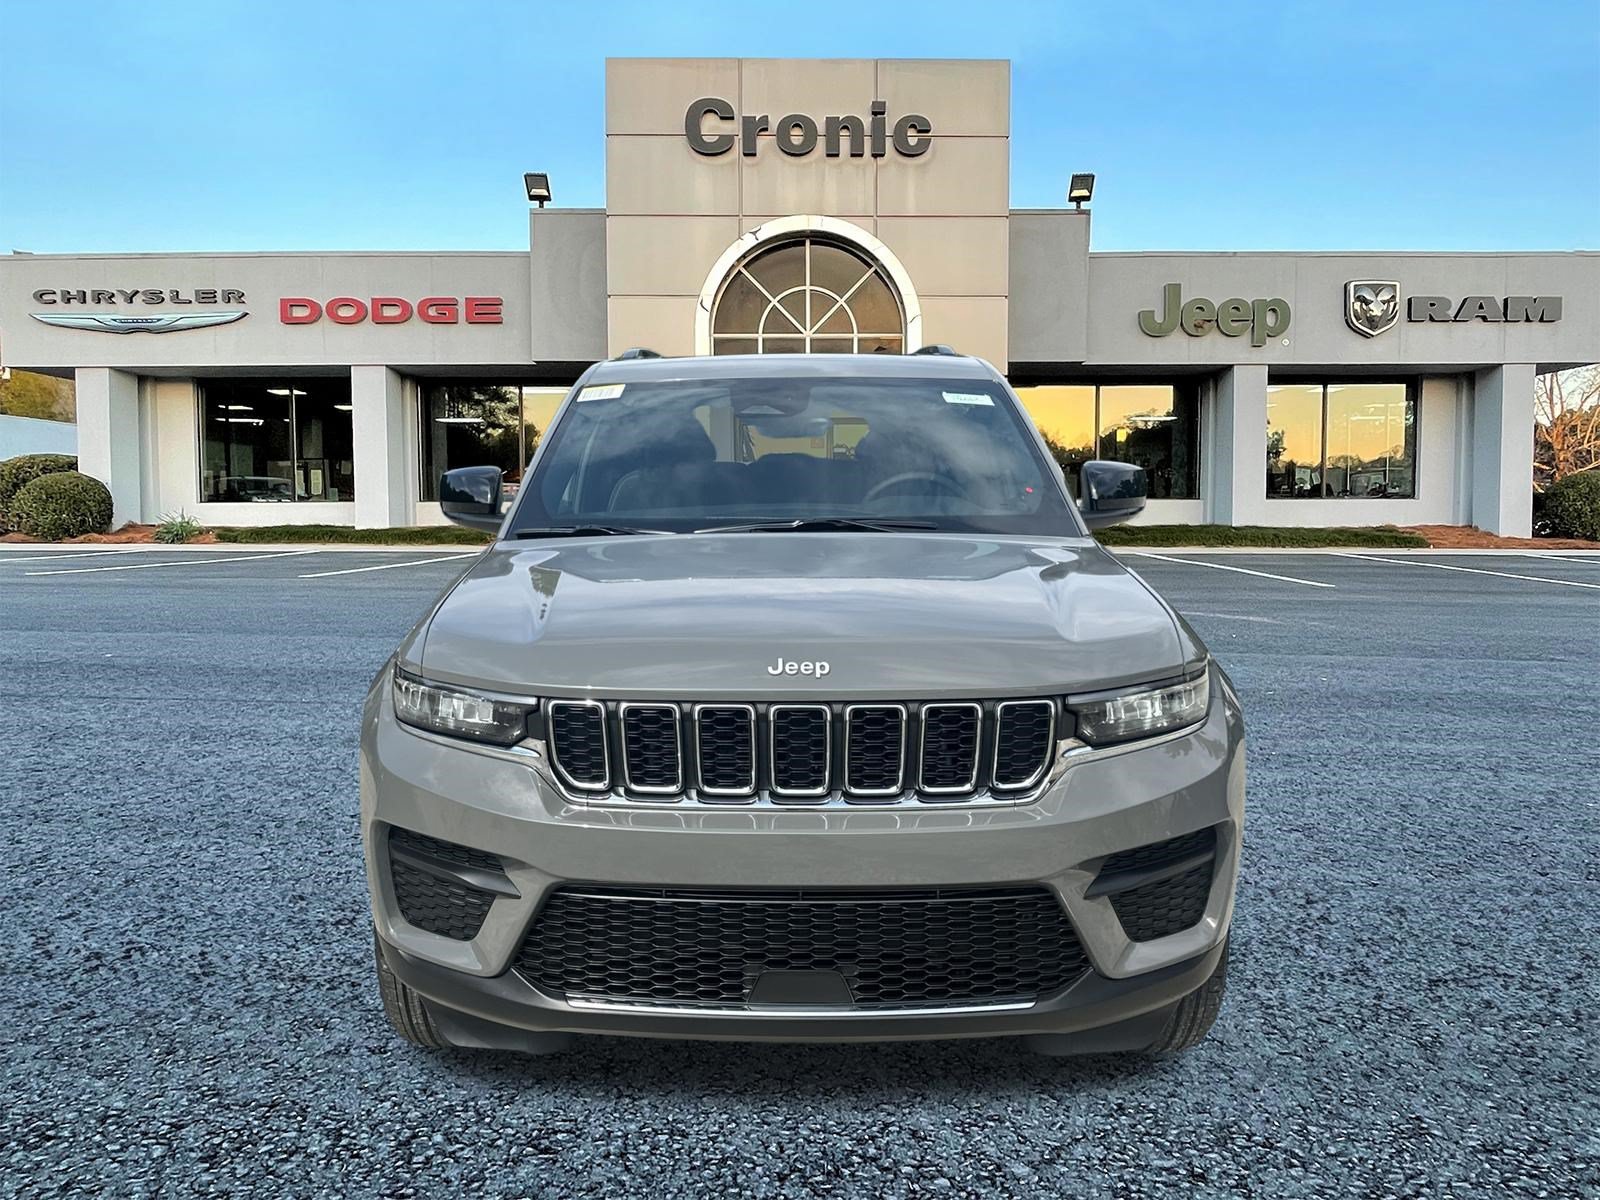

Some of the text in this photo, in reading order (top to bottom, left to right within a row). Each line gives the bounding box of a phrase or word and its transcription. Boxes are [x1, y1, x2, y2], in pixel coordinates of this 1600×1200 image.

[684, 97, 932, 157] Cronic
[32, 288, 247, 305] CHRYSLER
[1407, 295, 1564, 323] RAM
[279, 297, 504, 325] DODGE
[1138, 282, 1292, 347] Jeep
[767, 657, 831, 679] Jeep
